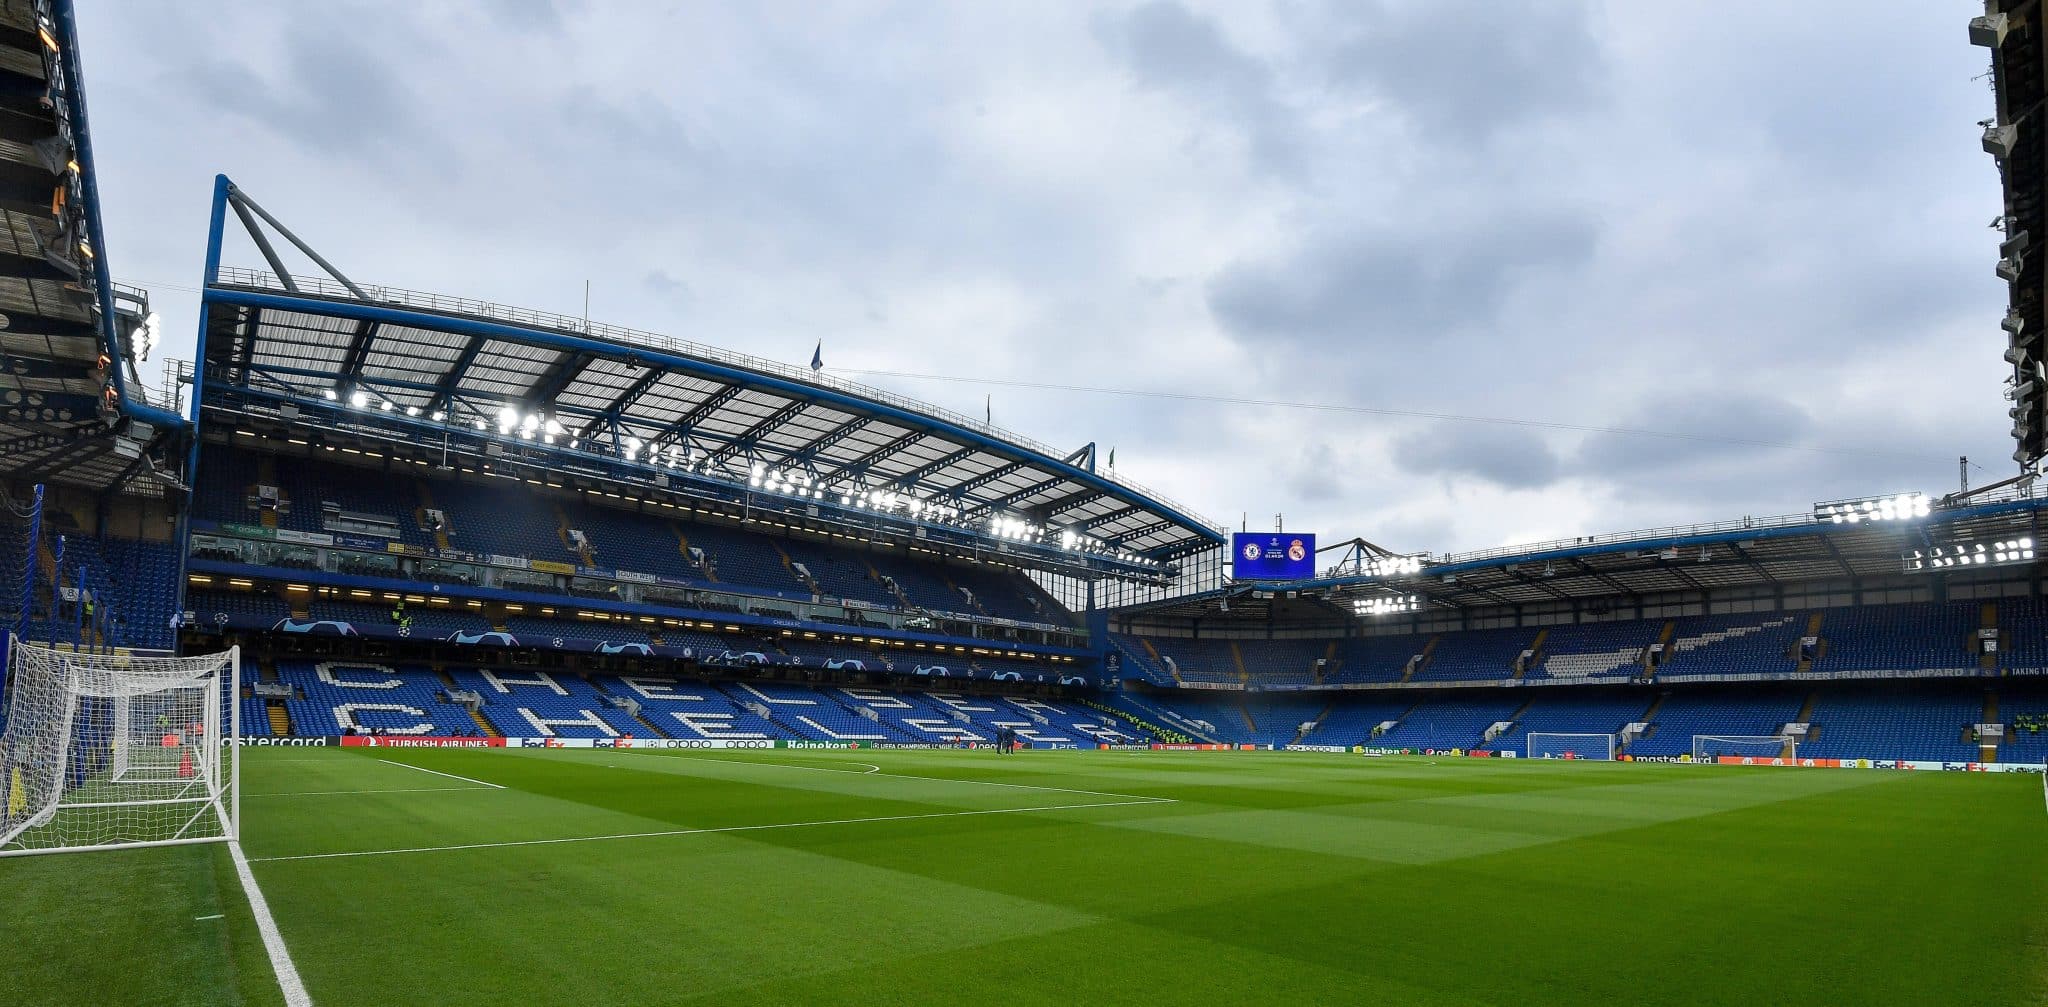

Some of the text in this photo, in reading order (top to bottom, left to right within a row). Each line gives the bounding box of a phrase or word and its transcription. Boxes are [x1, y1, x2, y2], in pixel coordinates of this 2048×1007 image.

[1789, 668, 1964, 680] SUPER FRANKIE LAMPARD
[2012, 667, 2040, 676] TAKING
[220, 735, 326, 747] astercard
[389, 739, 489, 748] TURKISH AIRLINES
[521, 738, 564, 749] FedEx
[592, 739, 632, 749] FedEx
[787, 740, 847, 749] Heineken
[897, 742, 931, 750] CHAMPIONS
[1872, 759, 1916, 772] FedEx
[1942, 761, 1988, 773] FedEx
